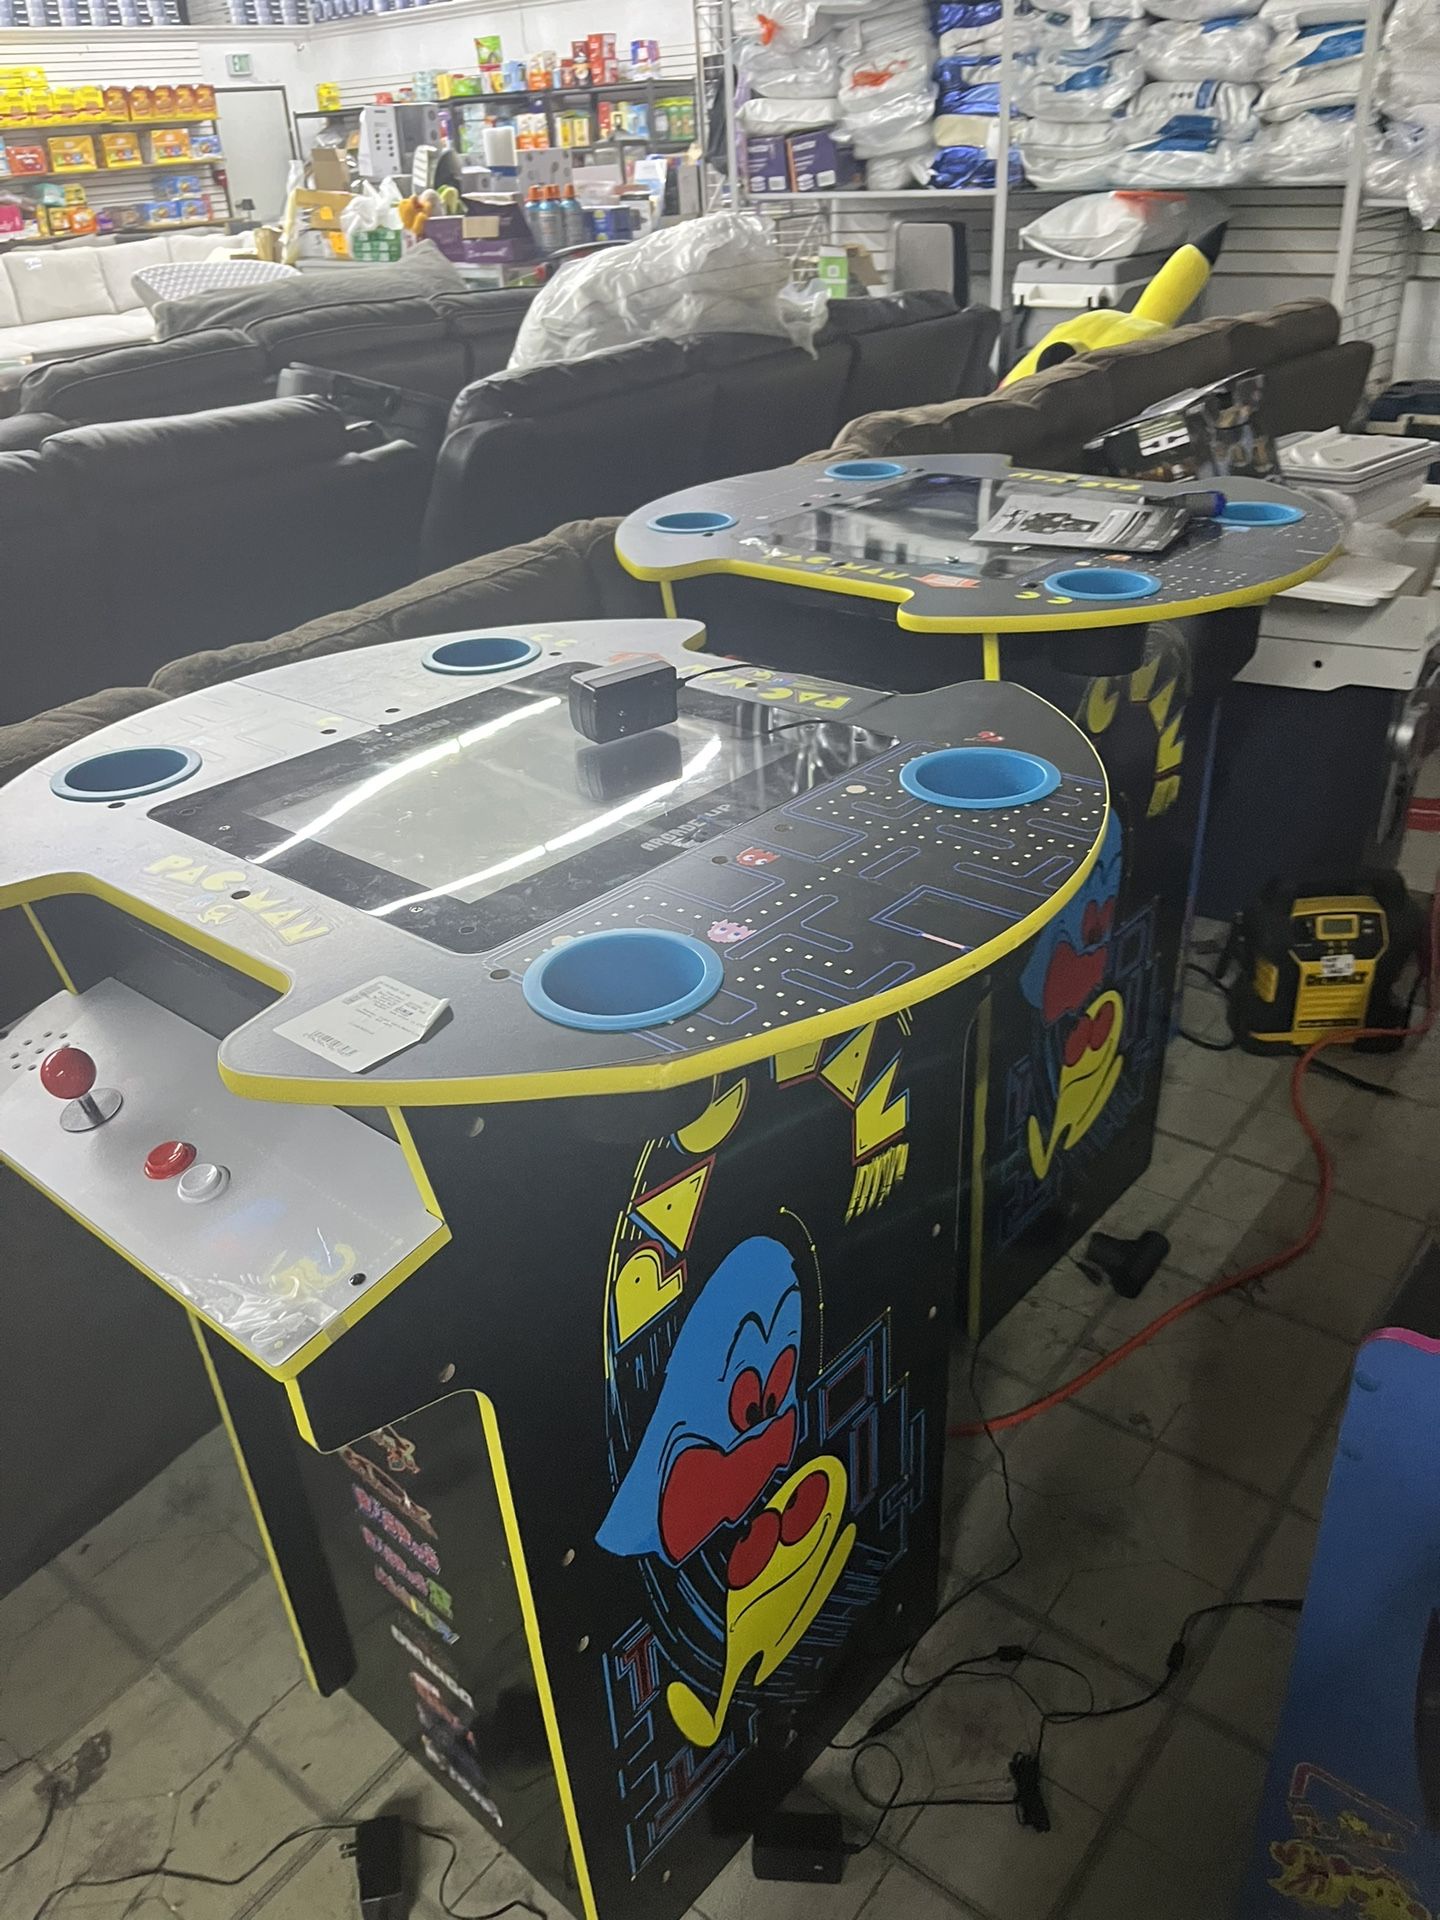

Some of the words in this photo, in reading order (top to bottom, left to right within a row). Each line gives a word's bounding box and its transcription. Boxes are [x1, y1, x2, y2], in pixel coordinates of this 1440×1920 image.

[758, 687, 851, 709] PAC
[143, 854, 247, 892] PAC
[239, 888, 331, 945] MAN
